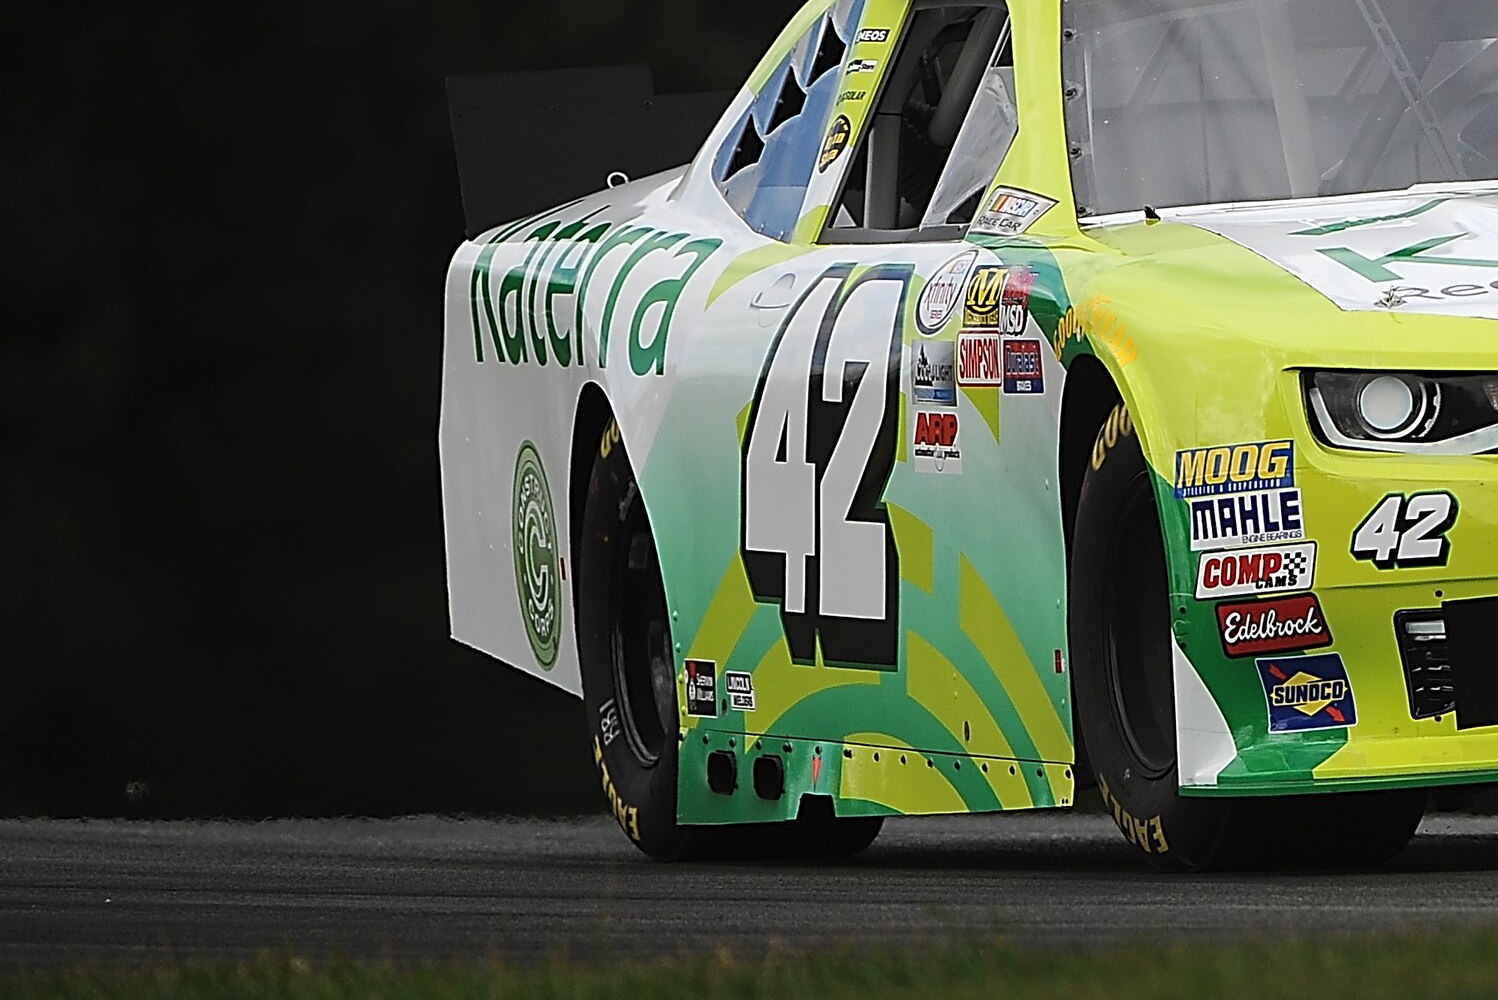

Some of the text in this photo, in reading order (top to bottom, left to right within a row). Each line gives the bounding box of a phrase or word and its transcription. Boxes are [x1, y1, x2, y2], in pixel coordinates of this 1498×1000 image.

[998, 217, 1022, 231] CAR
[471, 200, 723, 376] Katerra
[1001, 305, 1024, 334] MSD
[959, 338, 1000, 380] SIMPSON
[1005, 344, 1040, 376] Duralast
[914, 412, 959, 447] ARP
[743, 273, 907, 624] 42
[1178, 442, 1291, 488] MOOG
[1191, 490, 1301, 541] MAHLE
[1353, 493, 1453, 562] 42
[1242, 530, 1303, 544] ENGINE BEARINGS
[1203, 552, 1283, 589] COMP
[1255, 574, 1298, 590] CAMS
[1224, 606, 1323, 644] Edelbrock
[1274, 681, 1343, 704] SUNOCO
